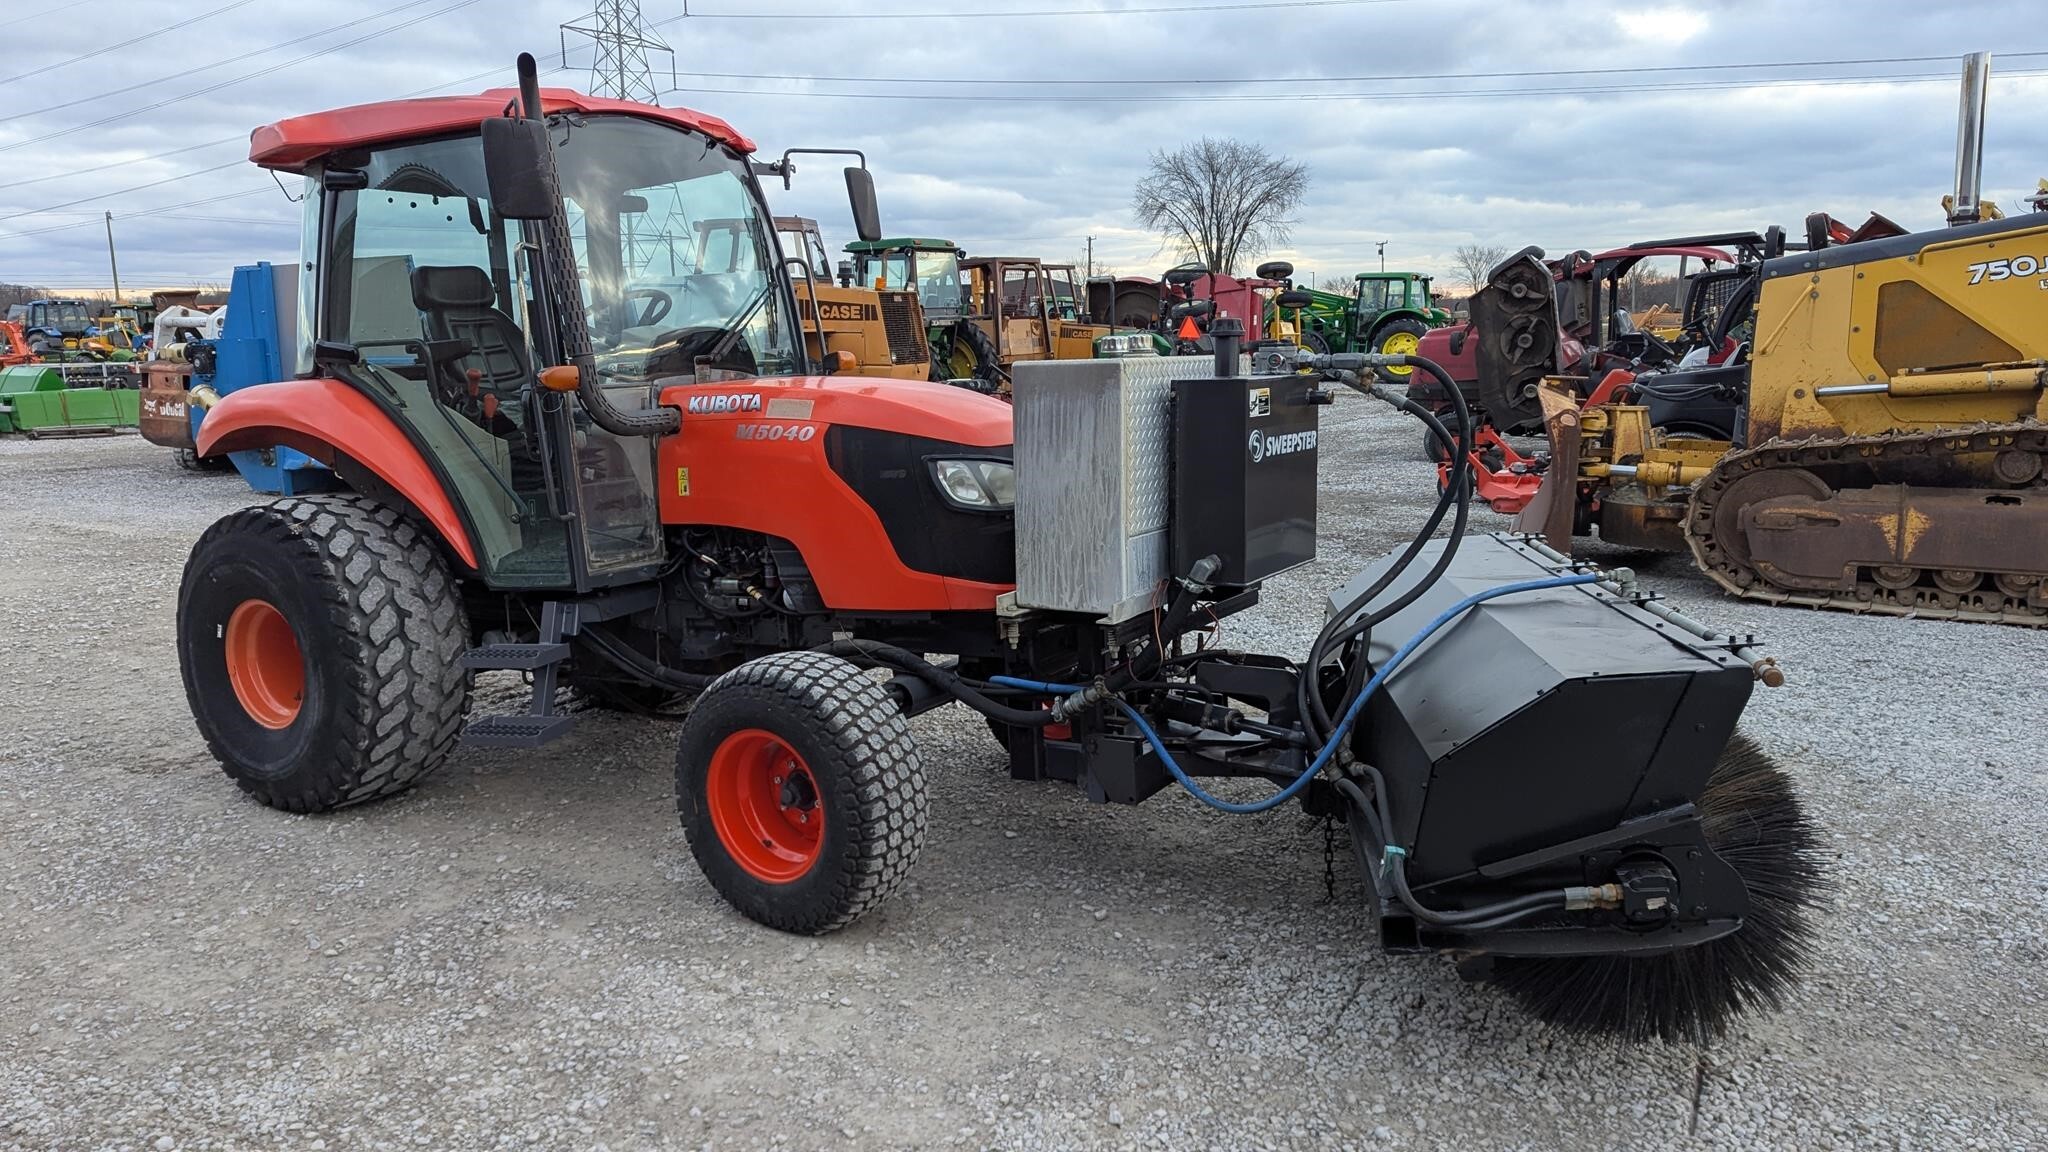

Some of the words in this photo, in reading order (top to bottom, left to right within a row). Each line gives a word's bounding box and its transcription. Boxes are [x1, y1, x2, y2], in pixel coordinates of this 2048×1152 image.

[820, 304, 861, 319] CASE
[1072, 330, 1092, 338] CASE
[687, 393, 762, 414] KUBOTA
[735, 423, 816, 442] M5040
[1265, 430, 1317, 457] SWEEPSTER
